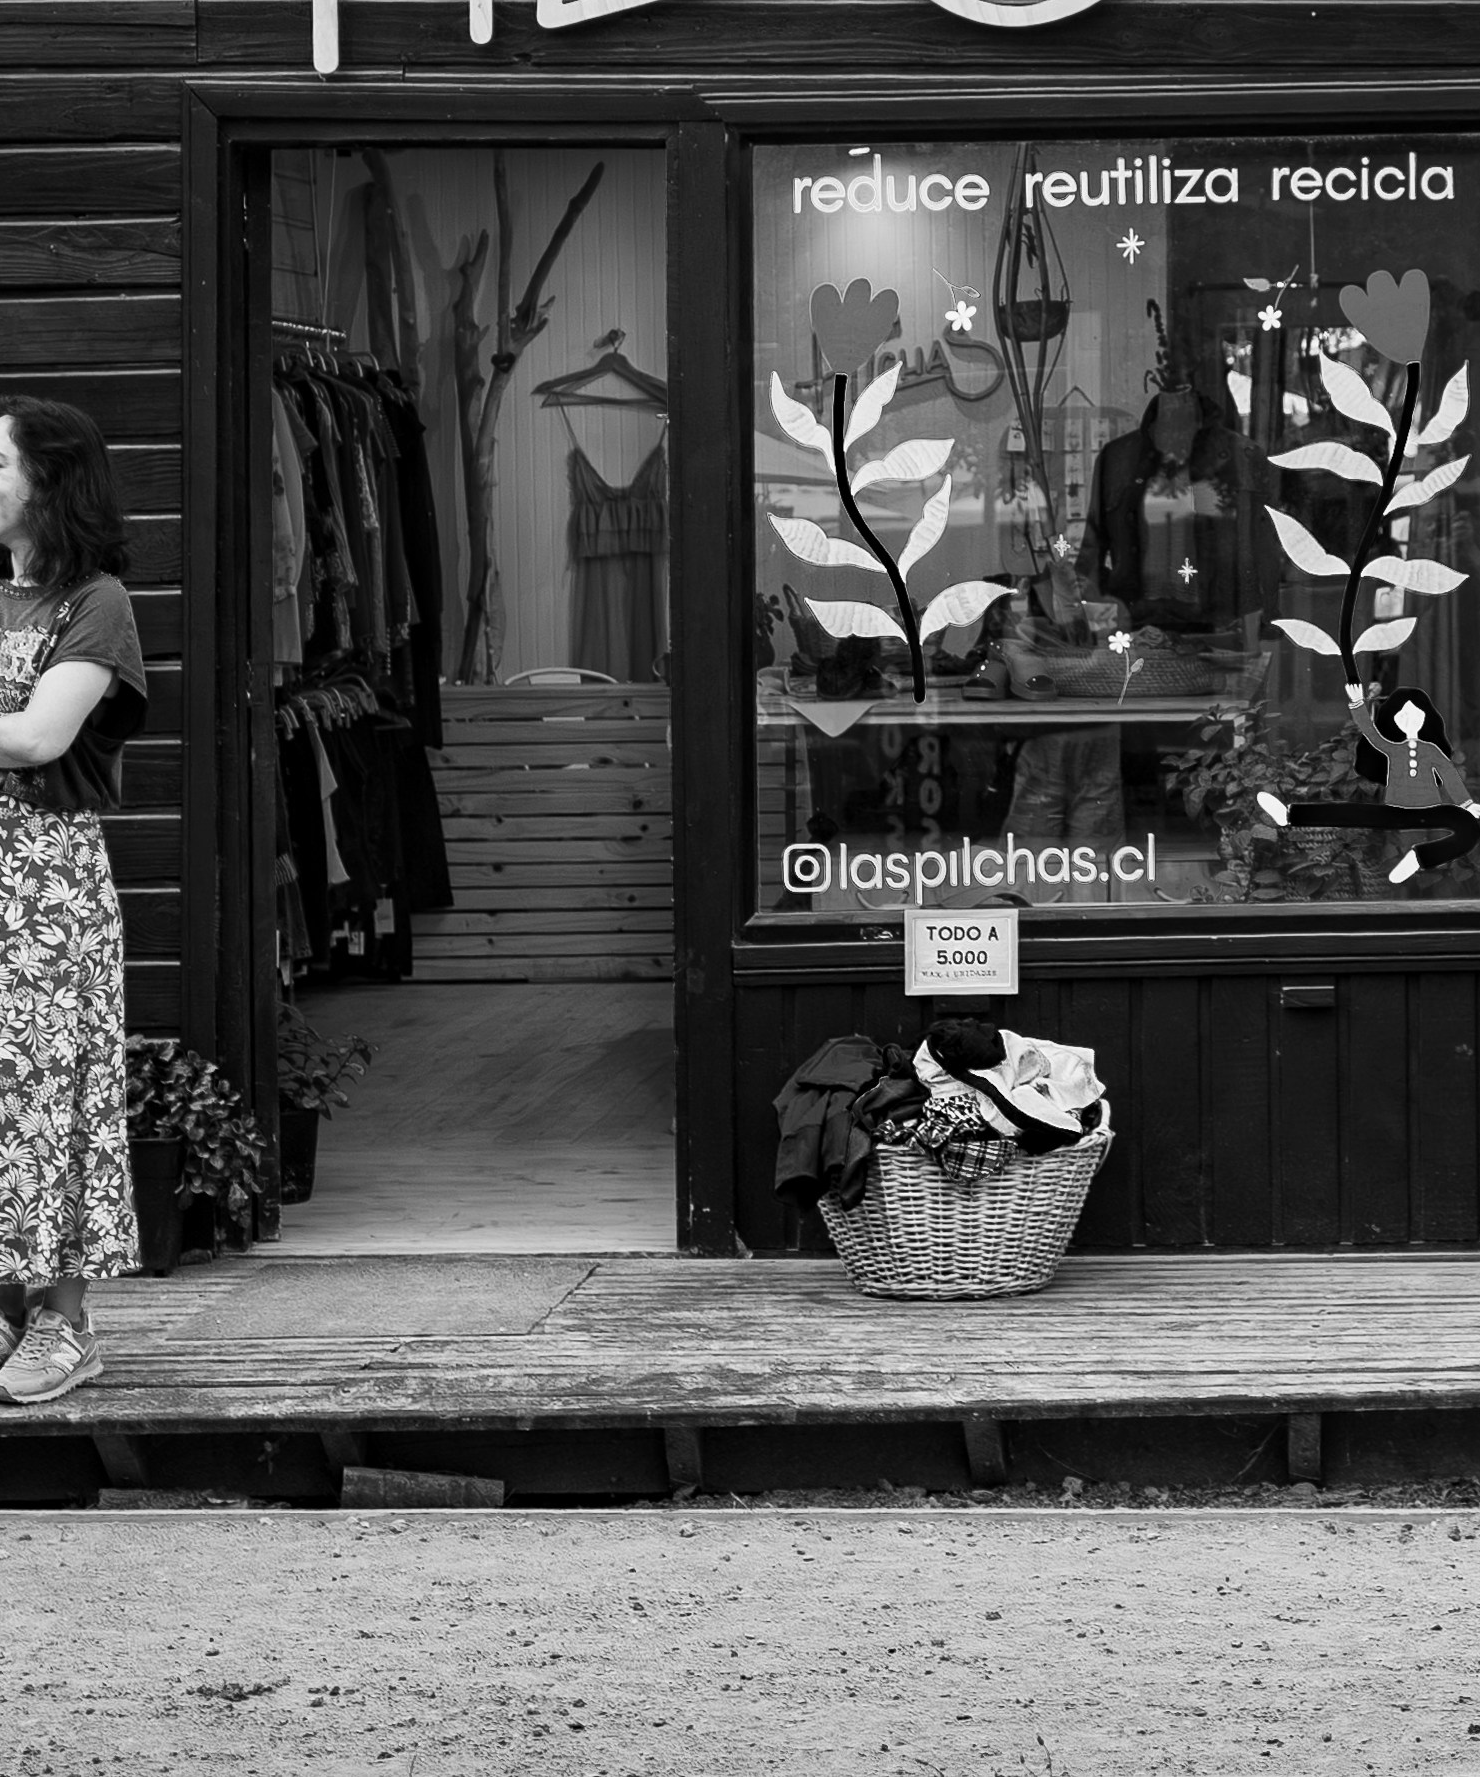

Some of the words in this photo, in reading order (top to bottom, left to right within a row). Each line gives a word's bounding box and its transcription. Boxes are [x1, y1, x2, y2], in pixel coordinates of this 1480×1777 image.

[792, 152, 991, 215] reduce
[1024, 155, 1240, 209] reutiliza
[1271, 152, 1455, 202] recicla
[839, 832, 1156, 906] laspilchas.cl
[926, 926, 982, 941] TODO
[988, 926, 999, 941] A
[937, 950, 988, 965] 5.000
